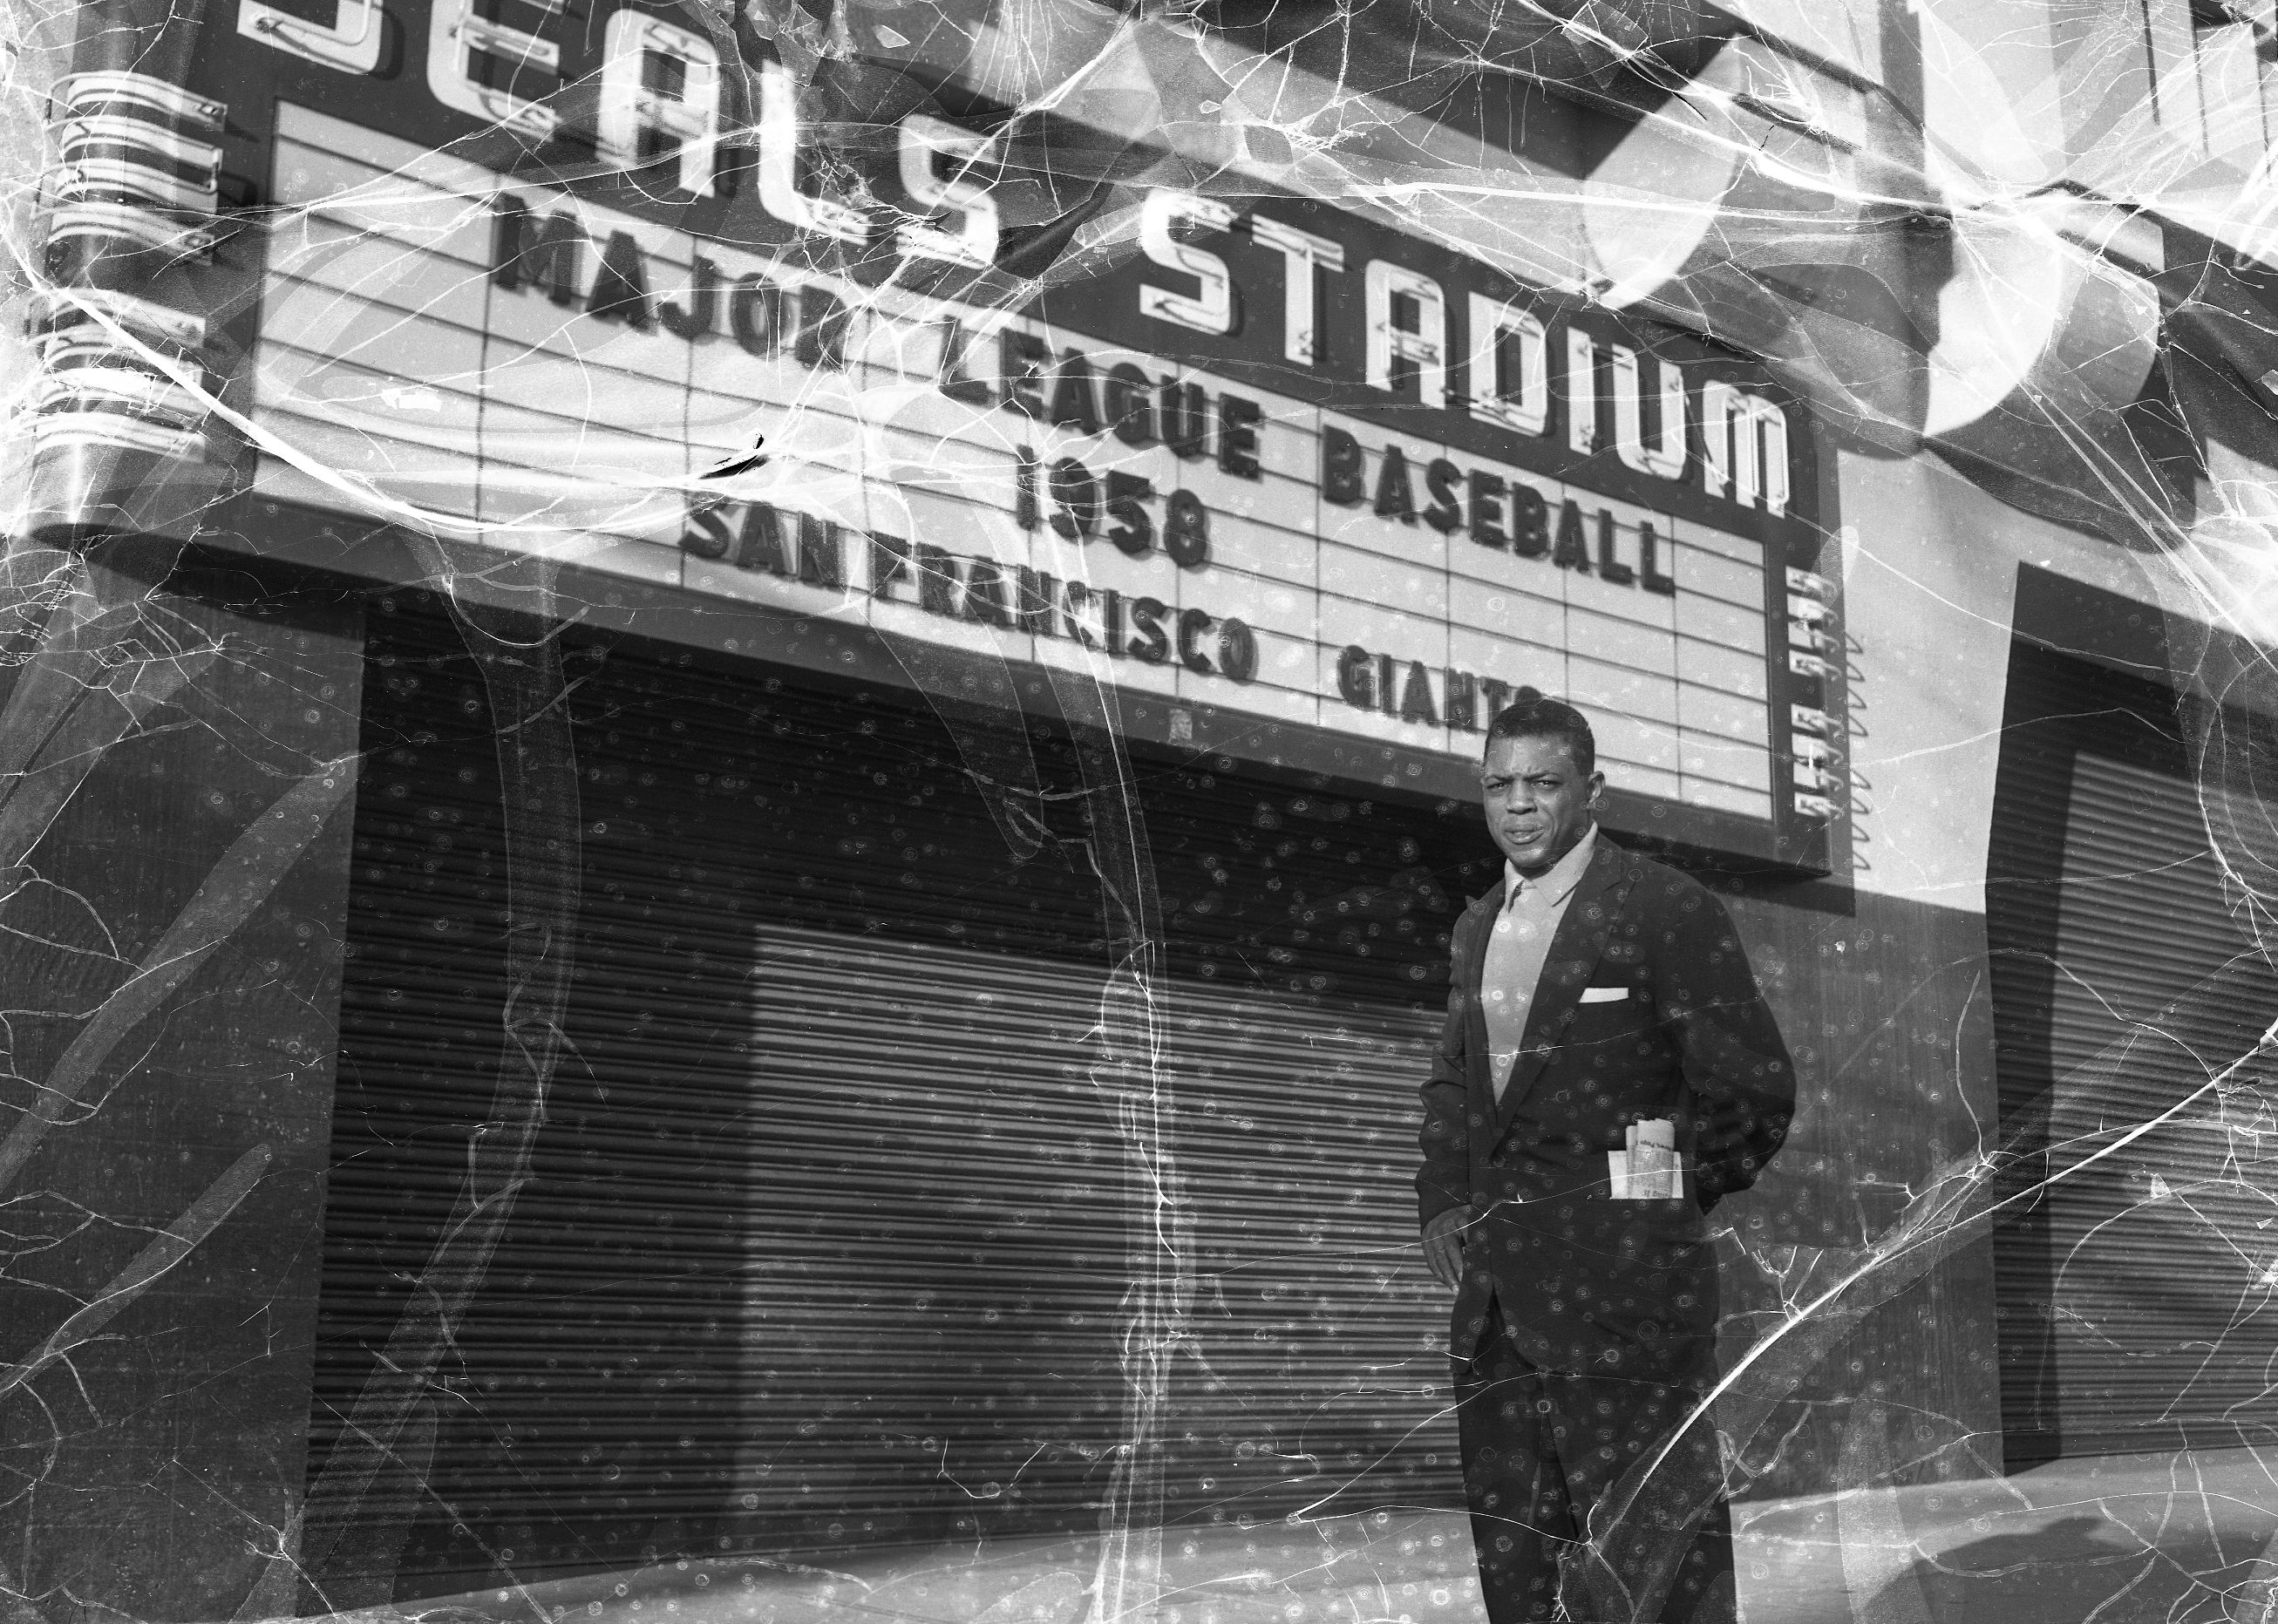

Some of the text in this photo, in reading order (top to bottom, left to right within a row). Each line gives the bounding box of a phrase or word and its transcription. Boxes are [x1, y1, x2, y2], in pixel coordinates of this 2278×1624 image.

[496, 194, 1676, 598] MAJOR LEAGUE BASEBALL
[1139, 187, 1790, 519] STADIUM
[678, 493, 1541, 734] SAN FRANCISCO GIANT
[1017, 444, 1210, 570] 1958
